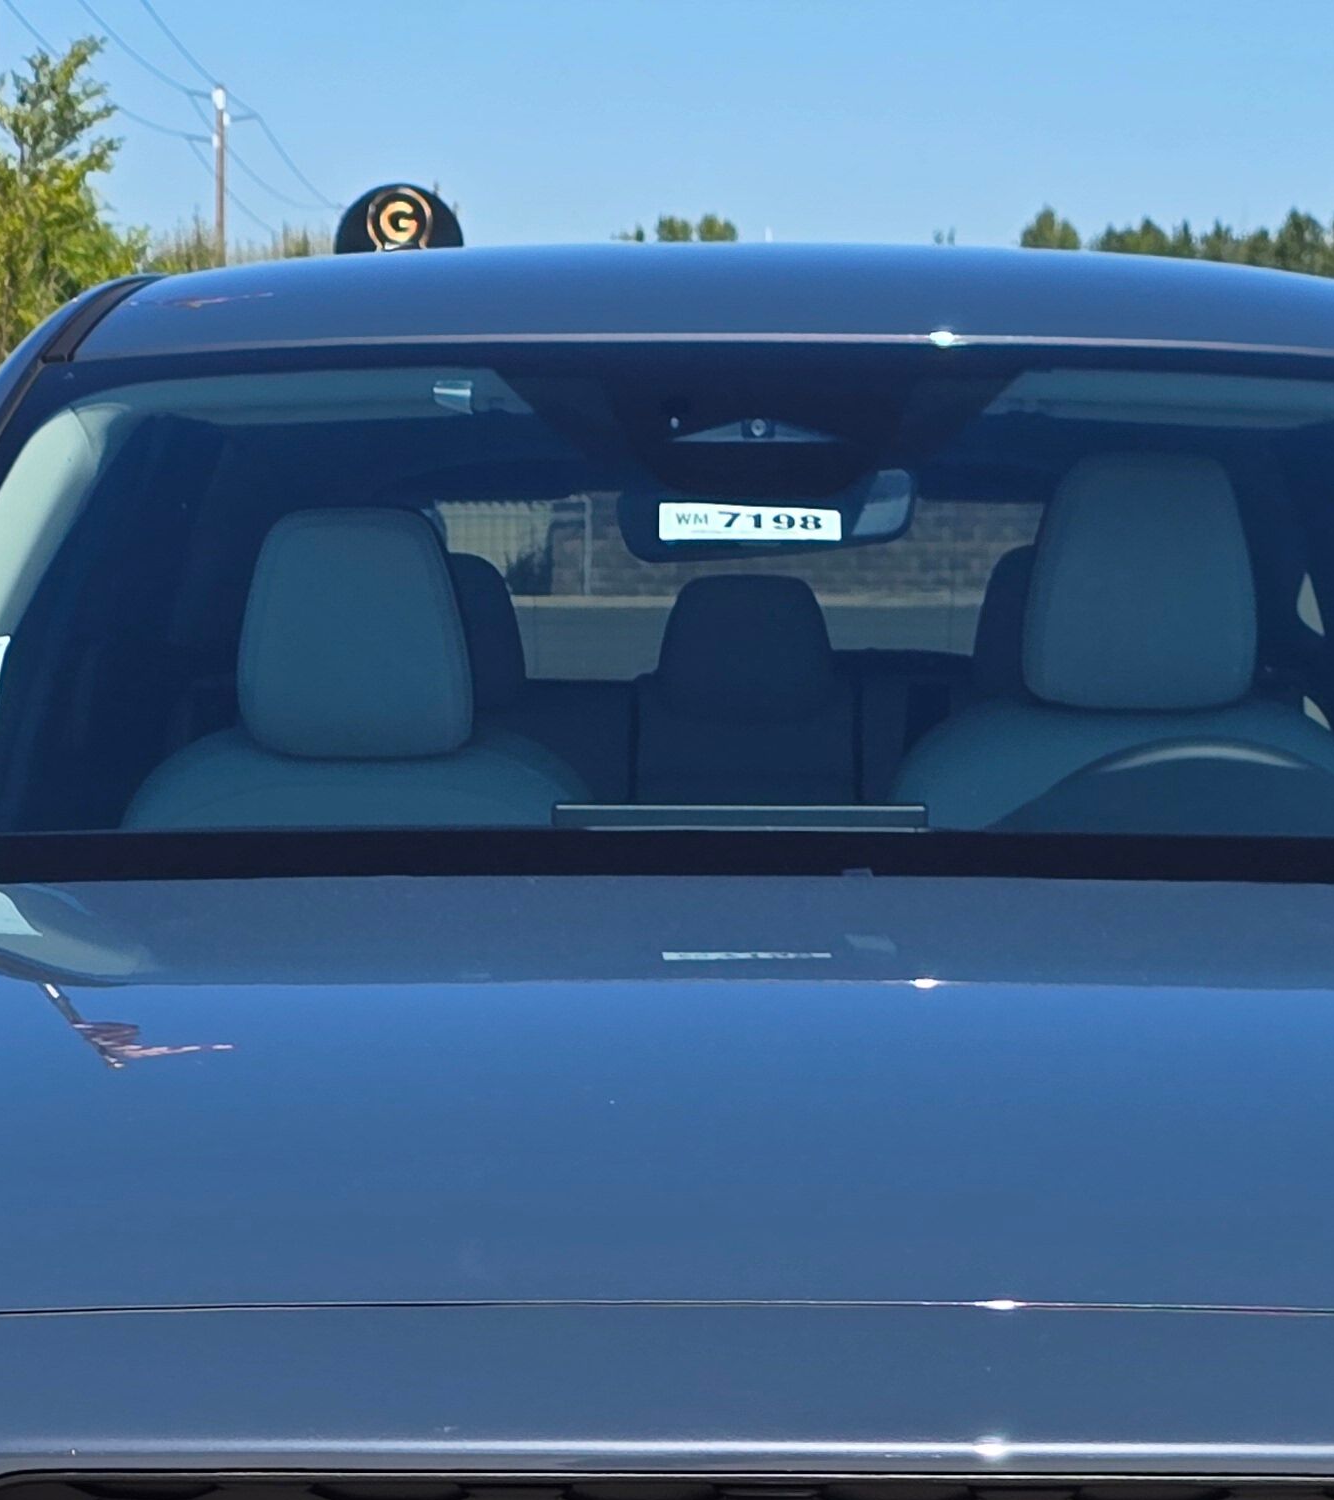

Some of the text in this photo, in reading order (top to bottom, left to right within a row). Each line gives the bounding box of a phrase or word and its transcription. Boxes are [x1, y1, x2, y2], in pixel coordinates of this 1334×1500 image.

[379, 201, 418, 243] G
[676, 511, 822, 530] WM 7198
